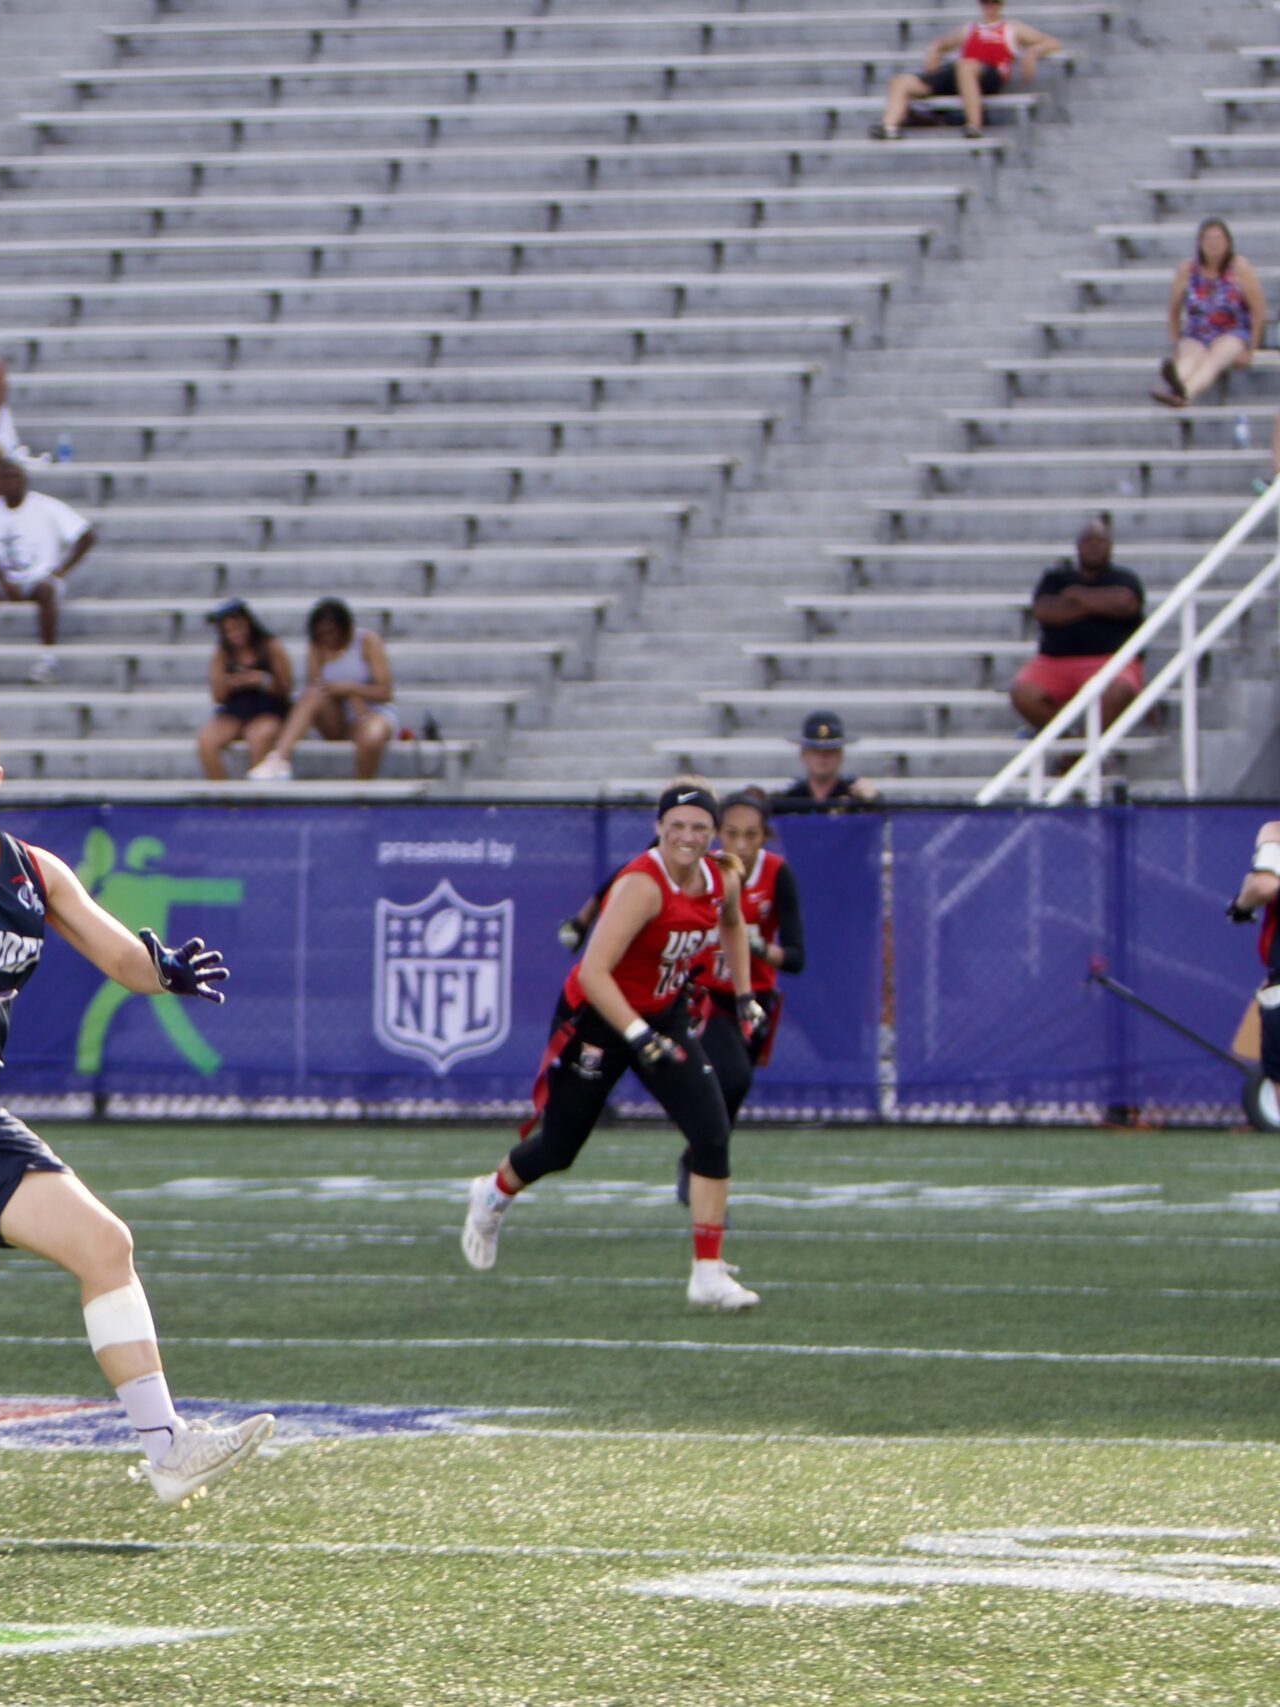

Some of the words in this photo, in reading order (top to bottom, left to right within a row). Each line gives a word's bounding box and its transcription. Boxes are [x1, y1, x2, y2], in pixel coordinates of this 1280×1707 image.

[379, 839, 484, 866] presented
[489, 839, 515, 869] by
[394, 968, 492, 1043] NFL
